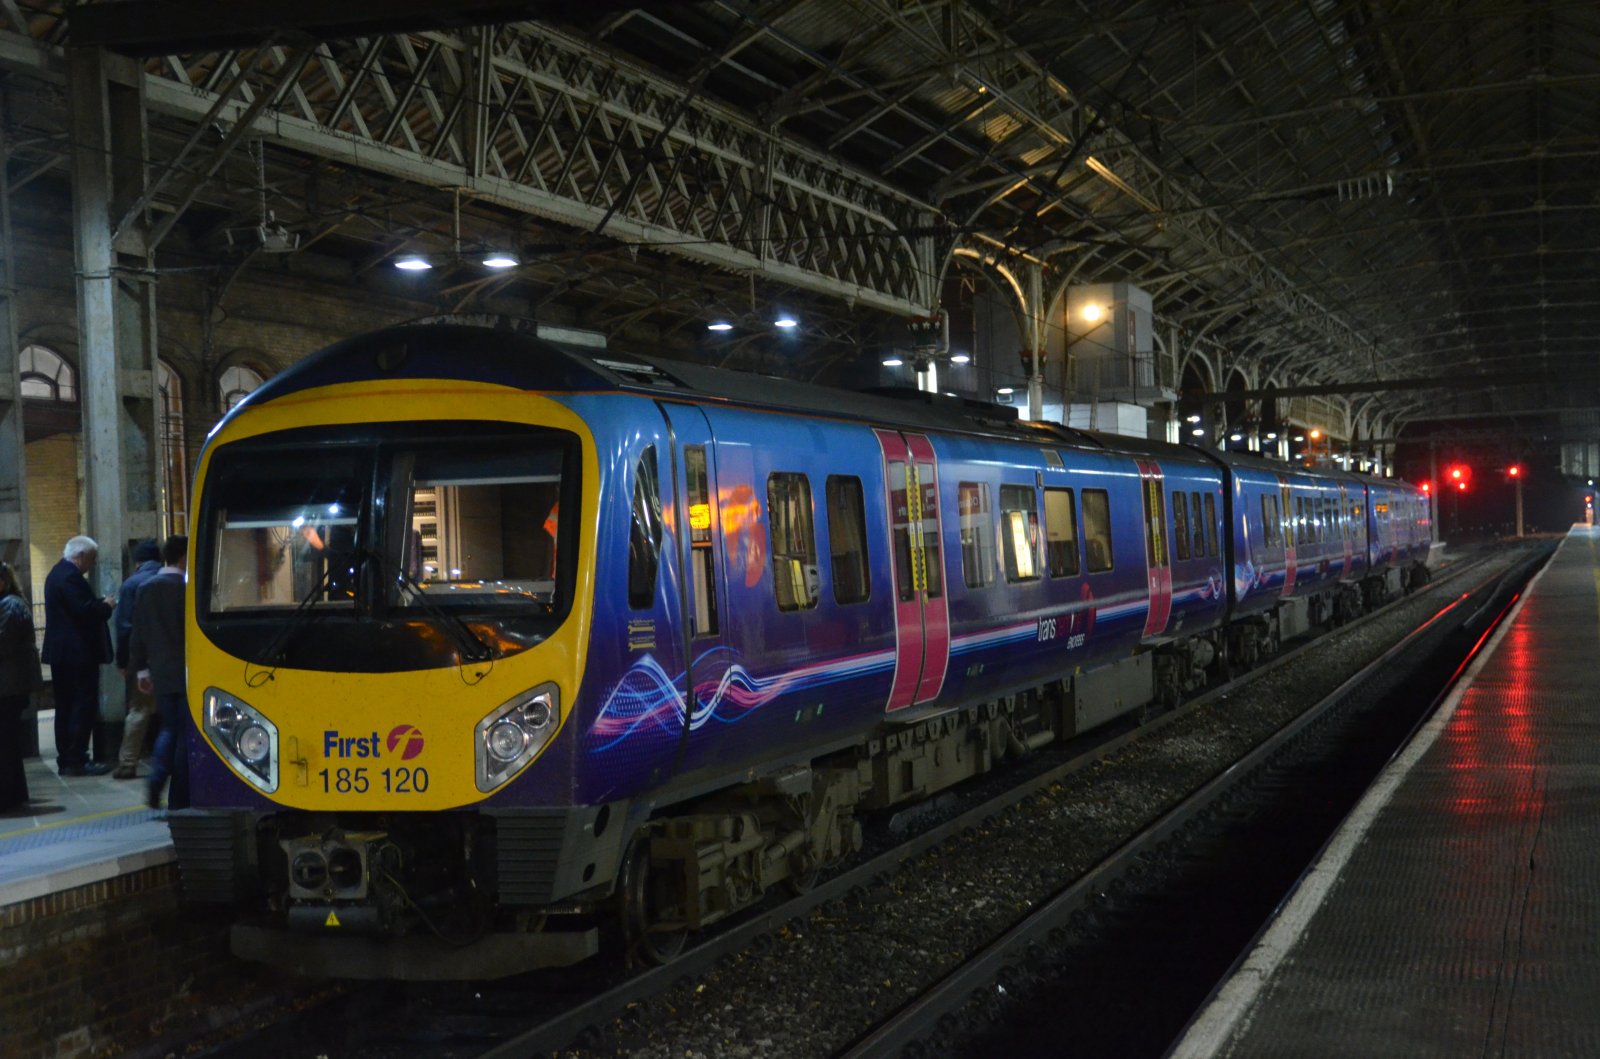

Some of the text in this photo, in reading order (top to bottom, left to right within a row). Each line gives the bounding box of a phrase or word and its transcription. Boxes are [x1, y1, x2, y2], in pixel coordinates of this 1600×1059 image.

[324, 731, 380, 758] First
[319, 767, 429, 793] 185 120
